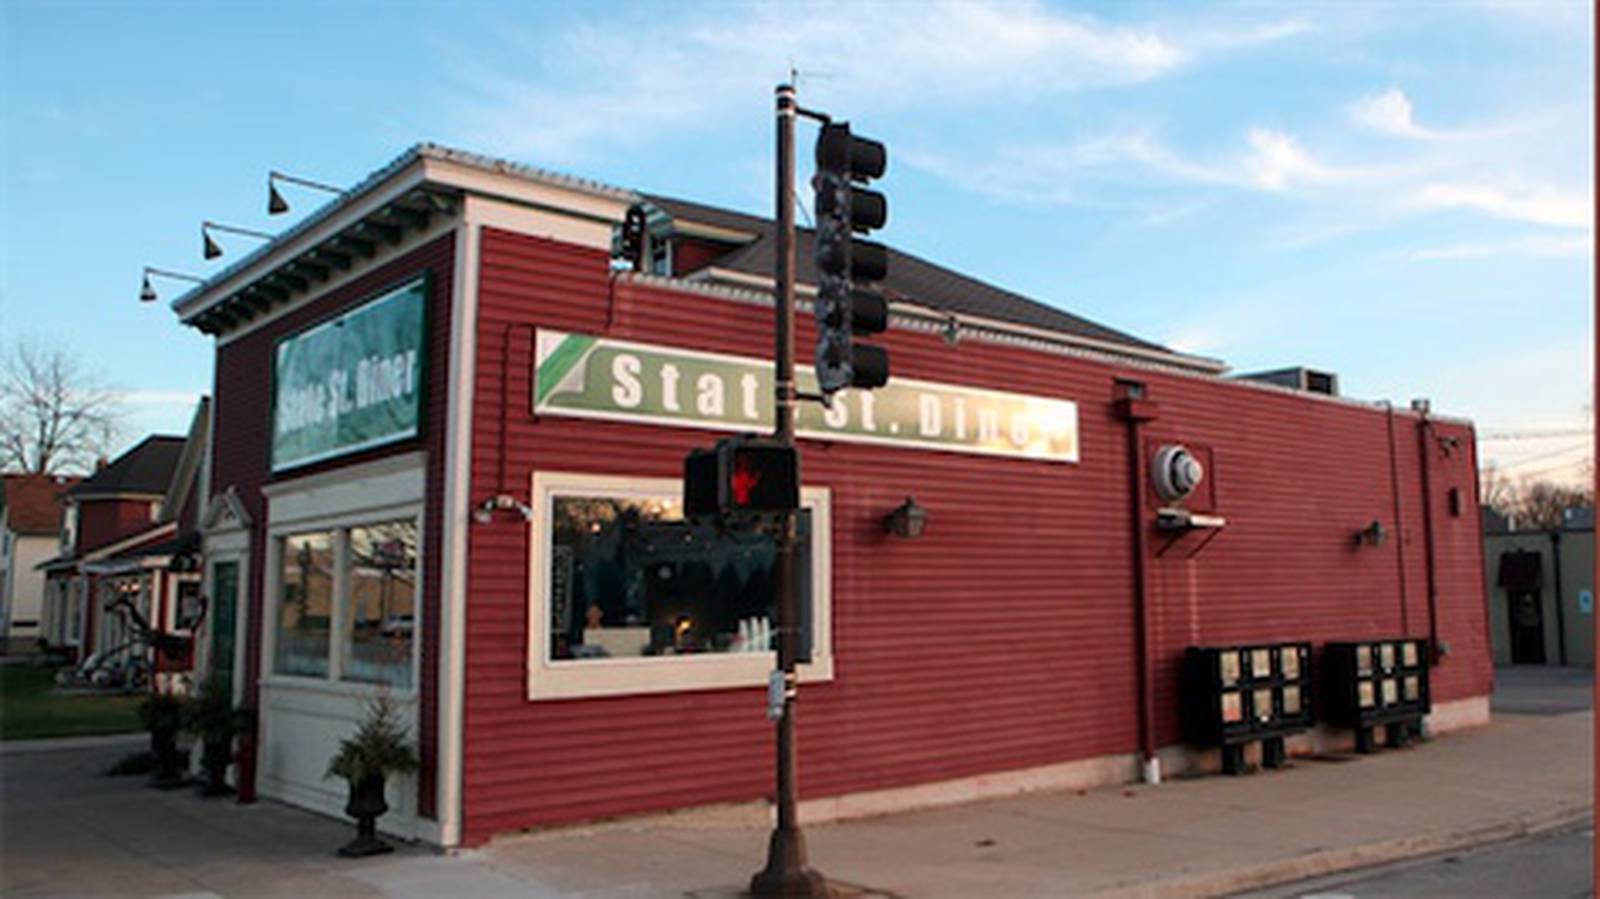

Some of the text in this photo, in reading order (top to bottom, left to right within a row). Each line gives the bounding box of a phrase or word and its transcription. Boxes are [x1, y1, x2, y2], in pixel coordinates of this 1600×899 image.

[356, 350, 416, 409] Diner
[611, 353, 1057, 452] Stat St. Dine
